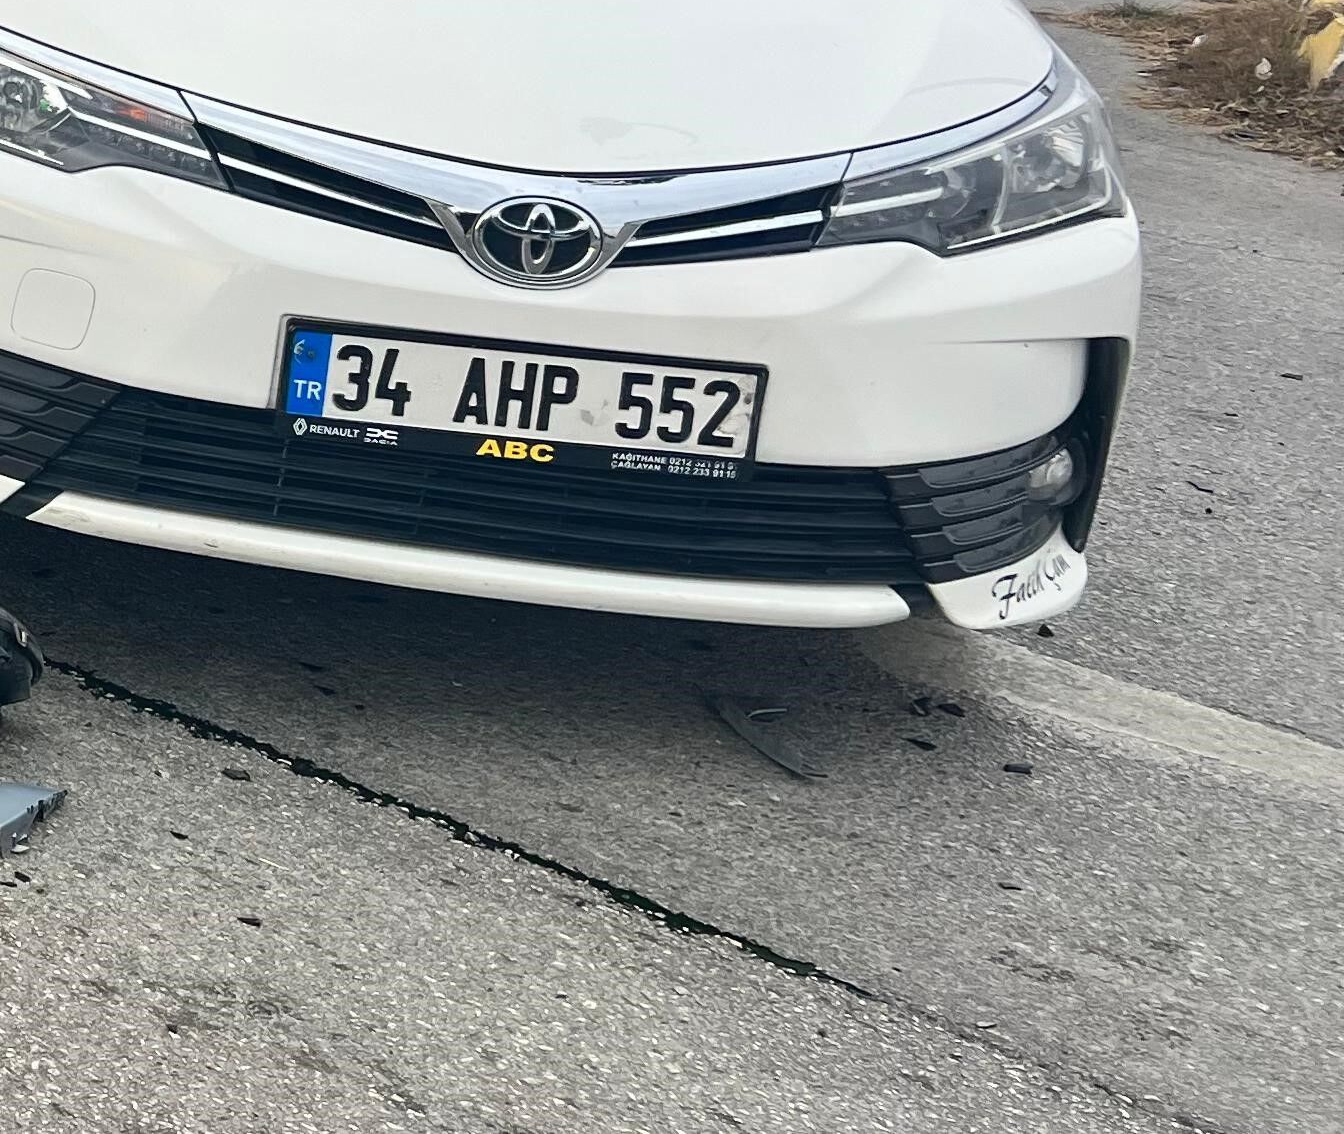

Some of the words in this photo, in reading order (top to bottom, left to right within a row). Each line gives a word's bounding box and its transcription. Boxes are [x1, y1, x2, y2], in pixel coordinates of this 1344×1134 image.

[293, 379, 322, 401] TR
[332, 344, 412, 417] 34
[452, 357, 580, 432] AHP
[614, 372, 743, 449] 552
[309, 424, 360, 439] RENAULT
[476, 439, 554, 463] ABC
[667, 465, 690, 475] 0212
[669, 457, 692, 467] 0212
